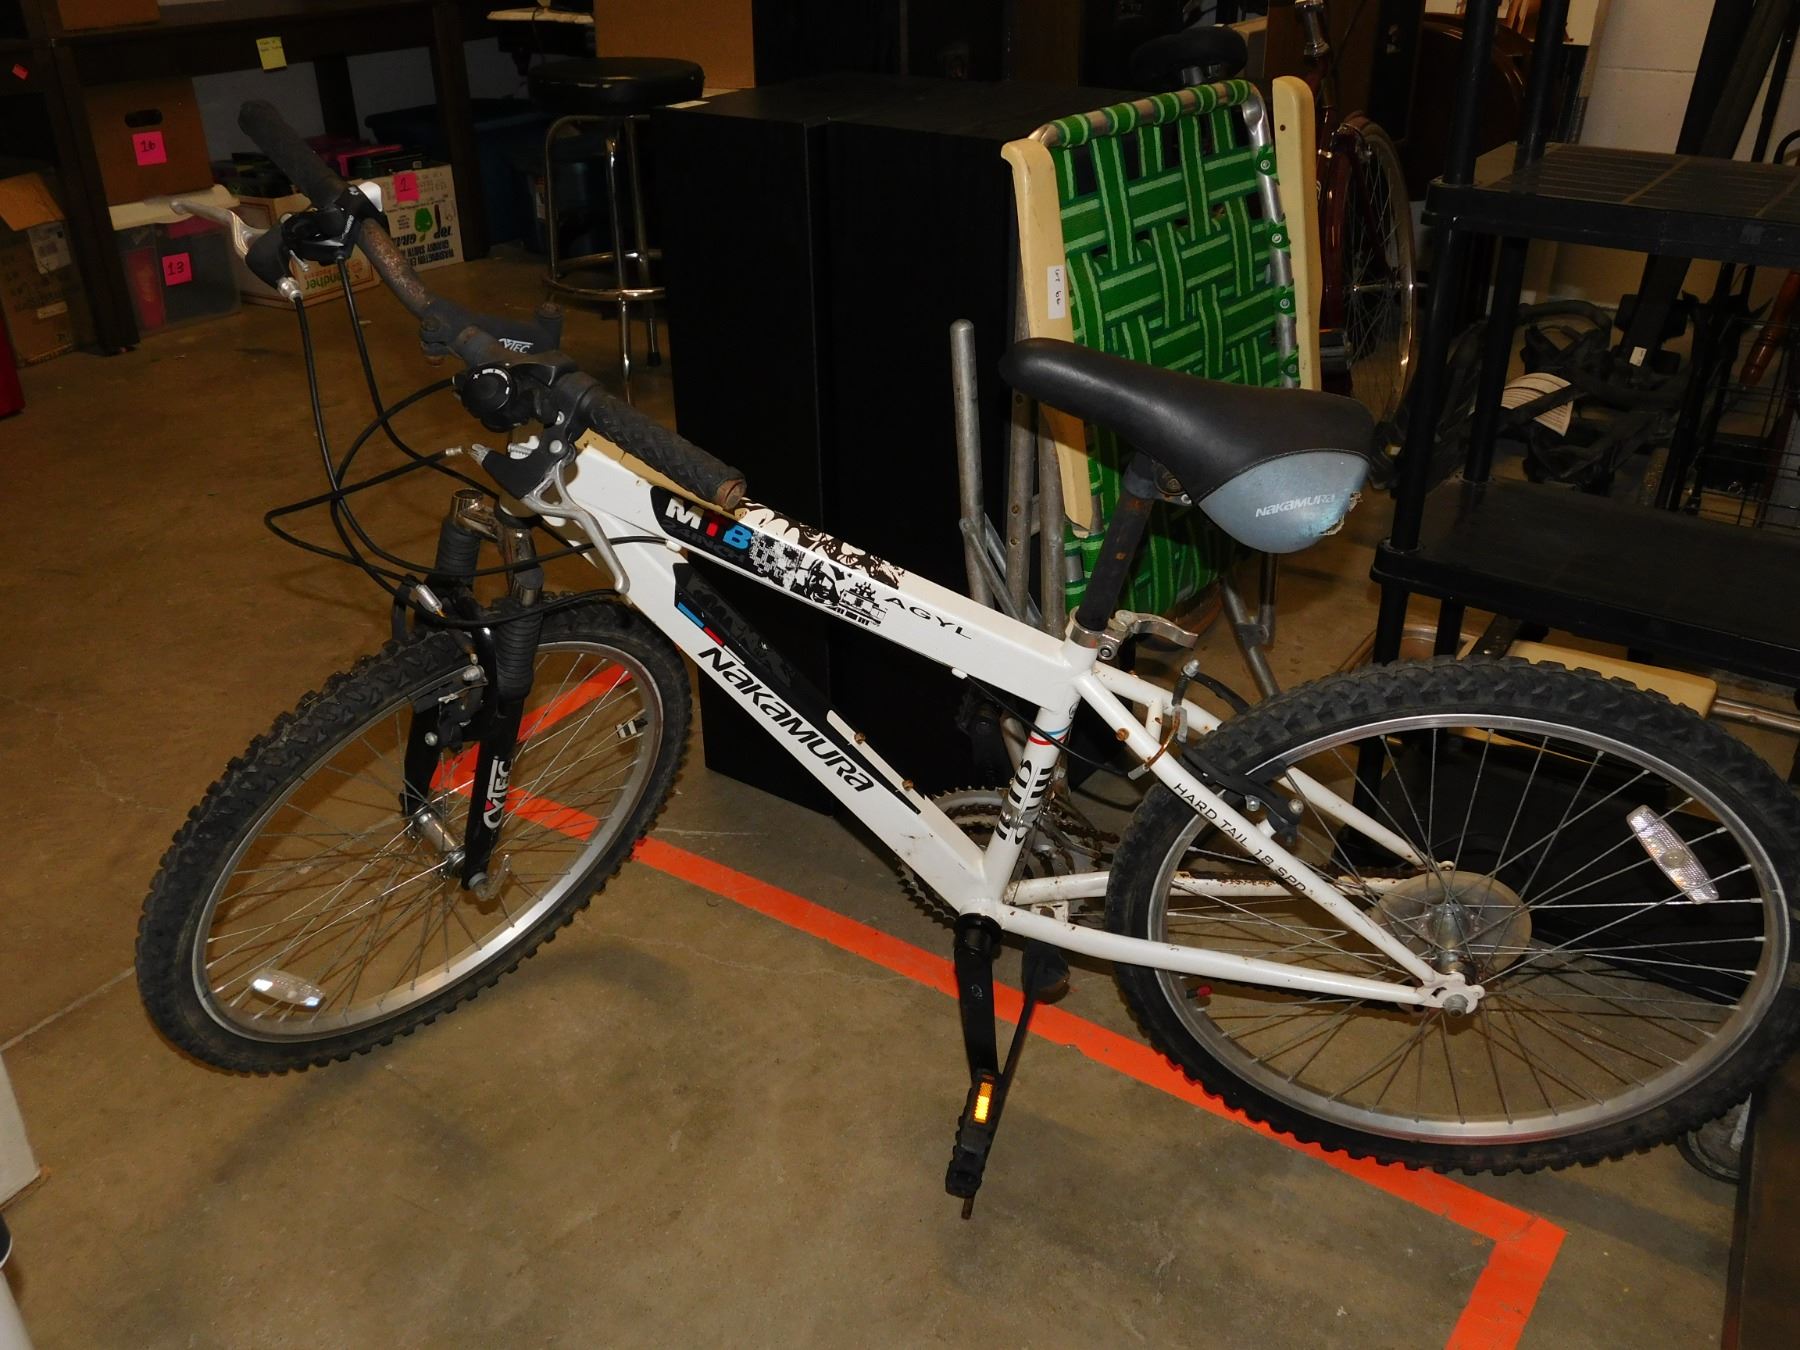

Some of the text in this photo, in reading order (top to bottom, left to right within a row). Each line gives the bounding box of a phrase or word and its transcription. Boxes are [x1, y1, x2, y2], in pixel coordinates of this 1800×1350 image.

[665, 497, 753, 550] MTB
[1174, 783, 1306, 891] HARD TAIL 18 SPD
